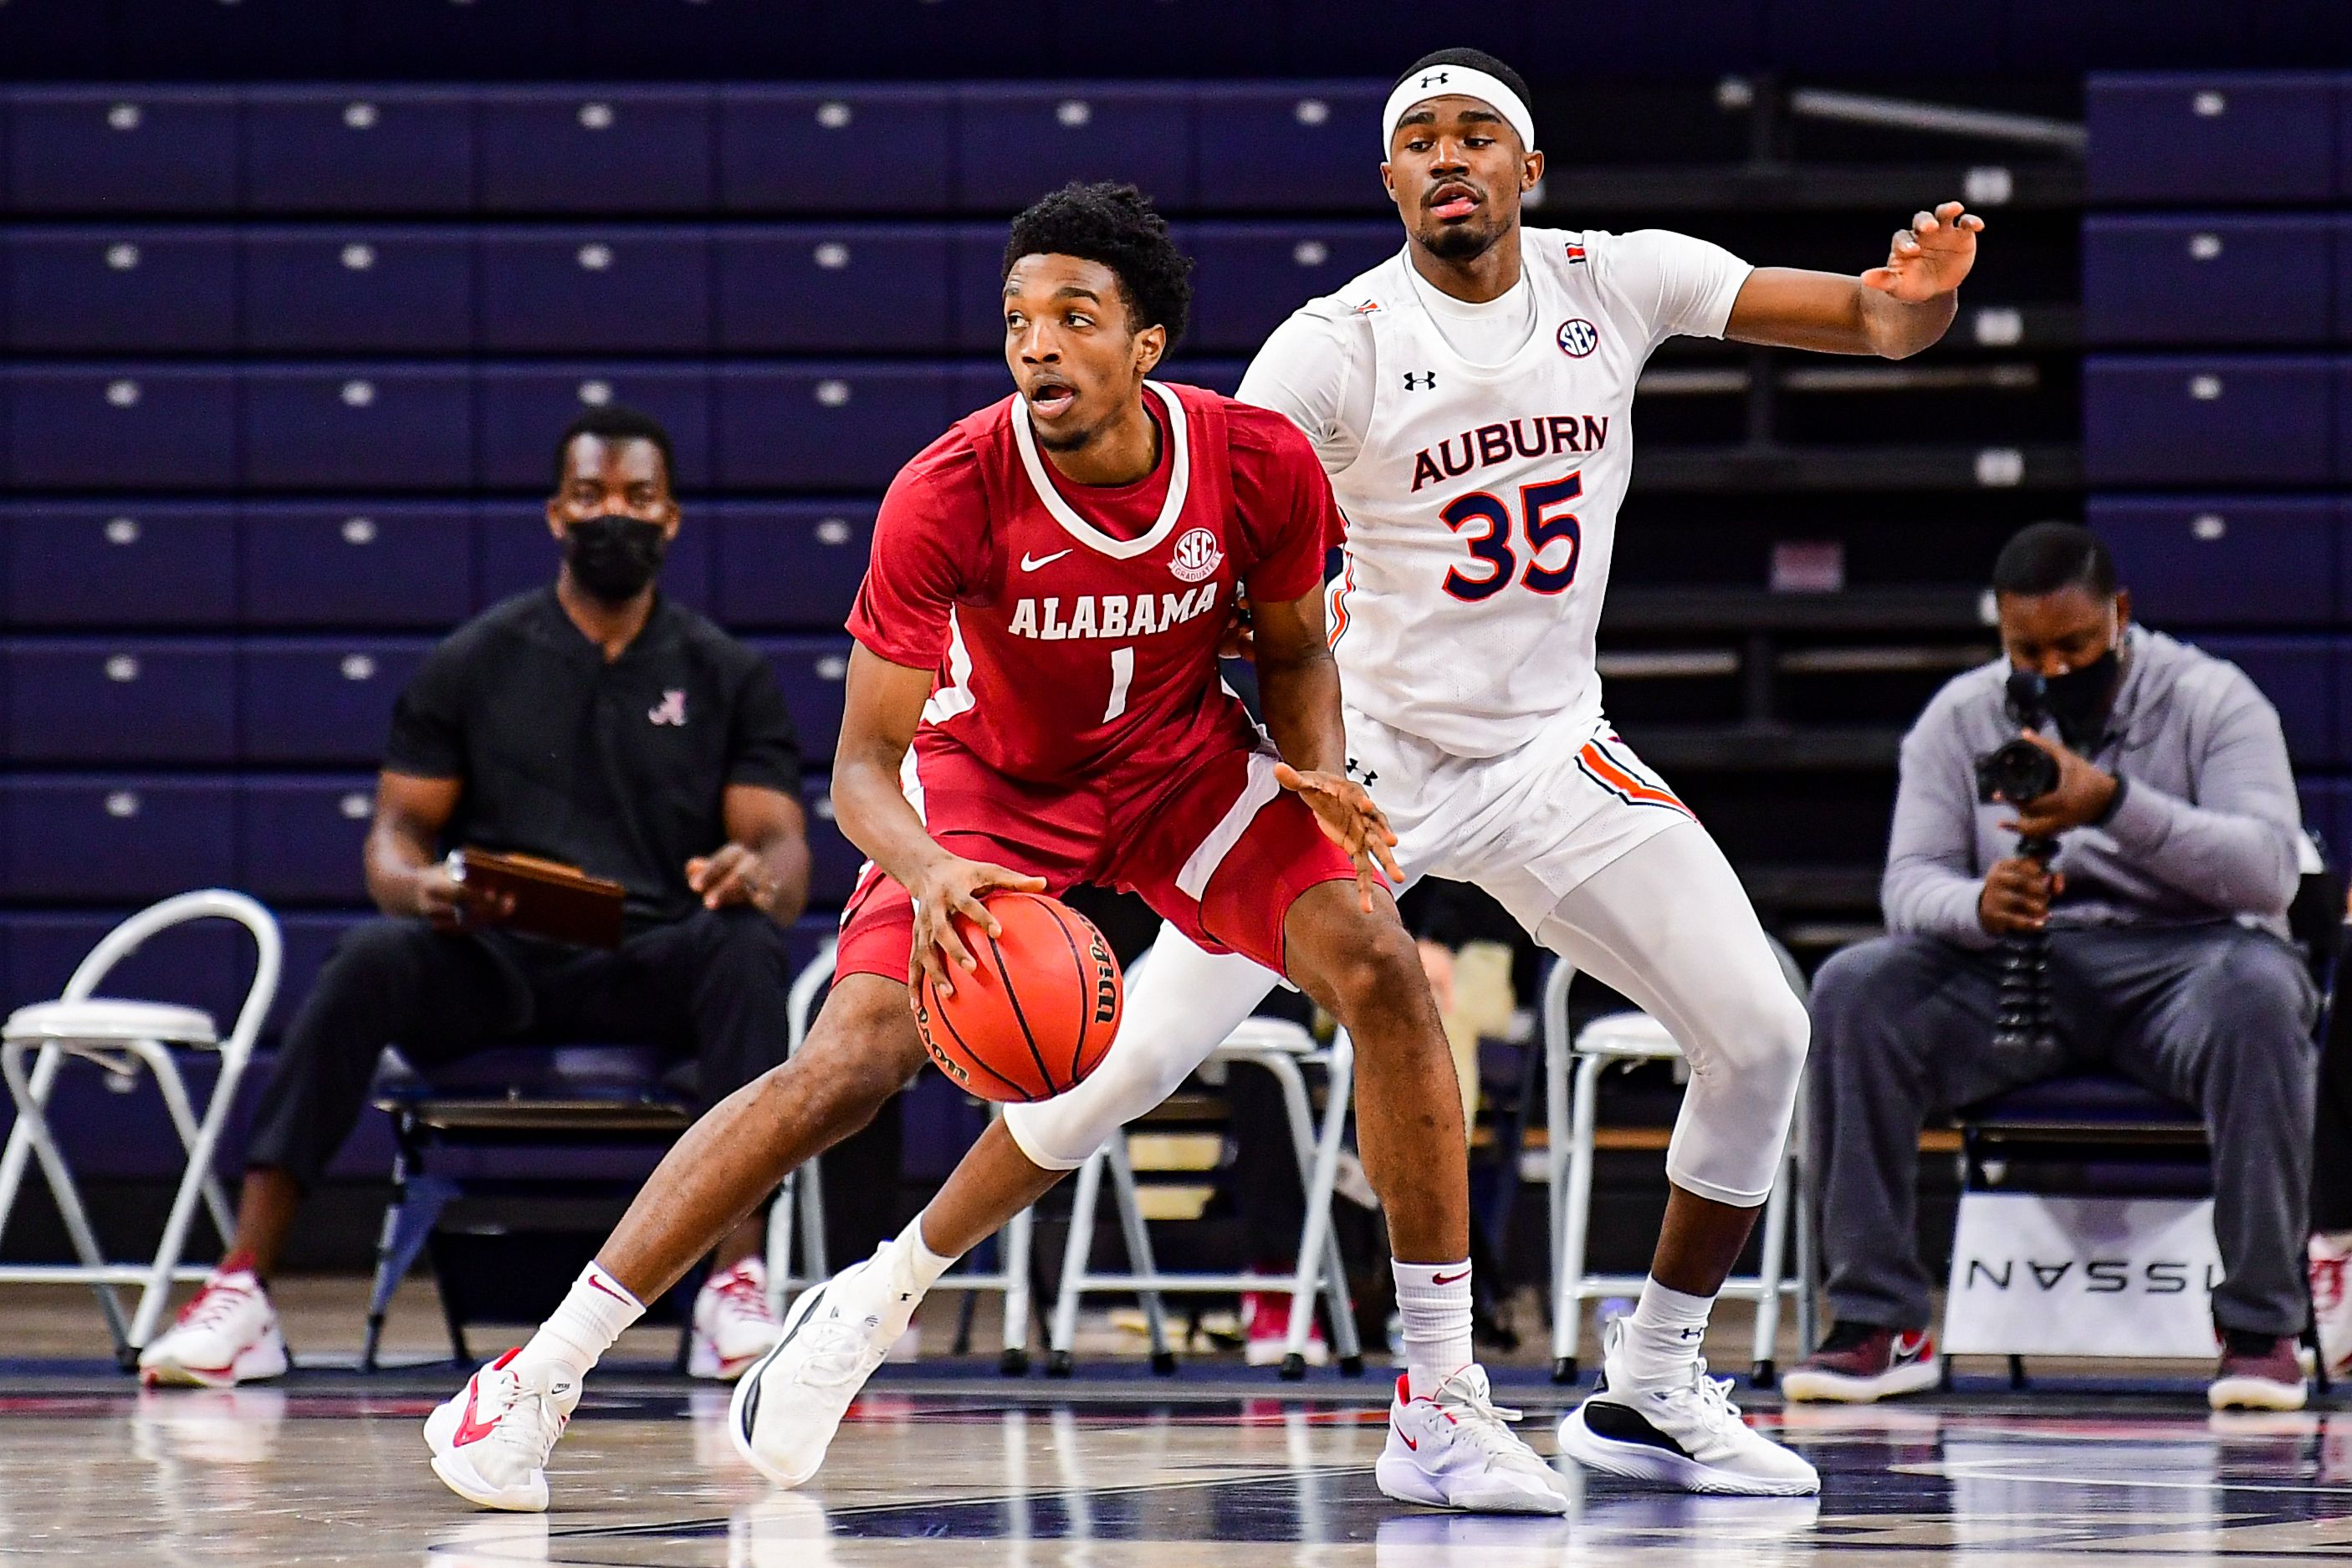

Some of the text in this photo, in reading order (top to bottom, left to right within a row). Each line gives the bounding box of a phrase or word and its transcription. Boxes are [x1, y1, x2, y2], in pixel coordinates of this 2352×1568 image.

[1559, 320, 1596, 355] SEC
[1410, 414, 1610, 493] AUBURN
[1178, 531, 1213, 569] SEC
[1443, 473, 1582, 601] 35
[1174, 561, 1216, 580] GRADUATE
[1008, 582, 1218, 641] ALABAMA
[1103, 647, 1133, 723] 1
[1966, 1259, 2213, 1293] ISSAN
